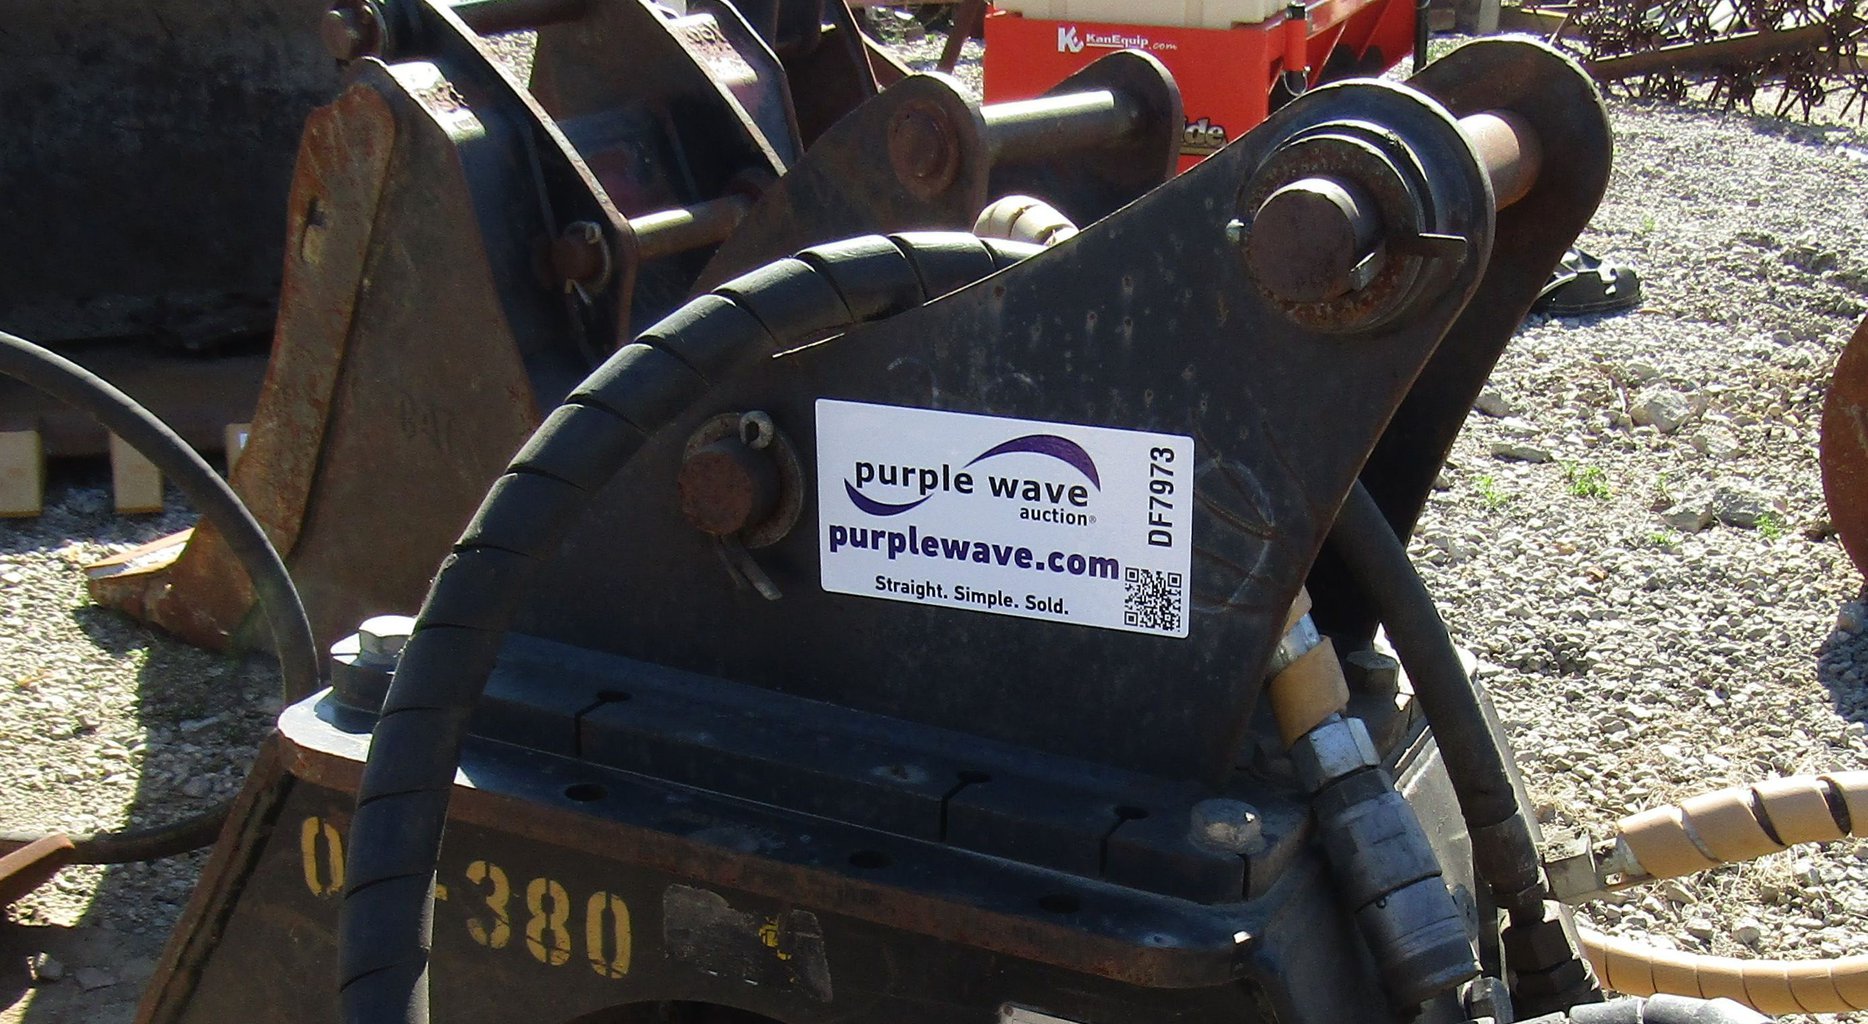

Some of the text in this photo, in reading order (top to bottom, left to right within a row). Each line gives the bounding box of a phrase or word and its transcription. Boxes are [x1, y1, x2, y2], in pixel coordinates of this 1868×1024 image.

[855, 461, 1089, 507] purple wave
[1148, 447, 1175, 547] DF7973
[829, 523, 1119, 580] purplewave.com
[875, 575, 1069, 616] Straight. Simple. Sold.
